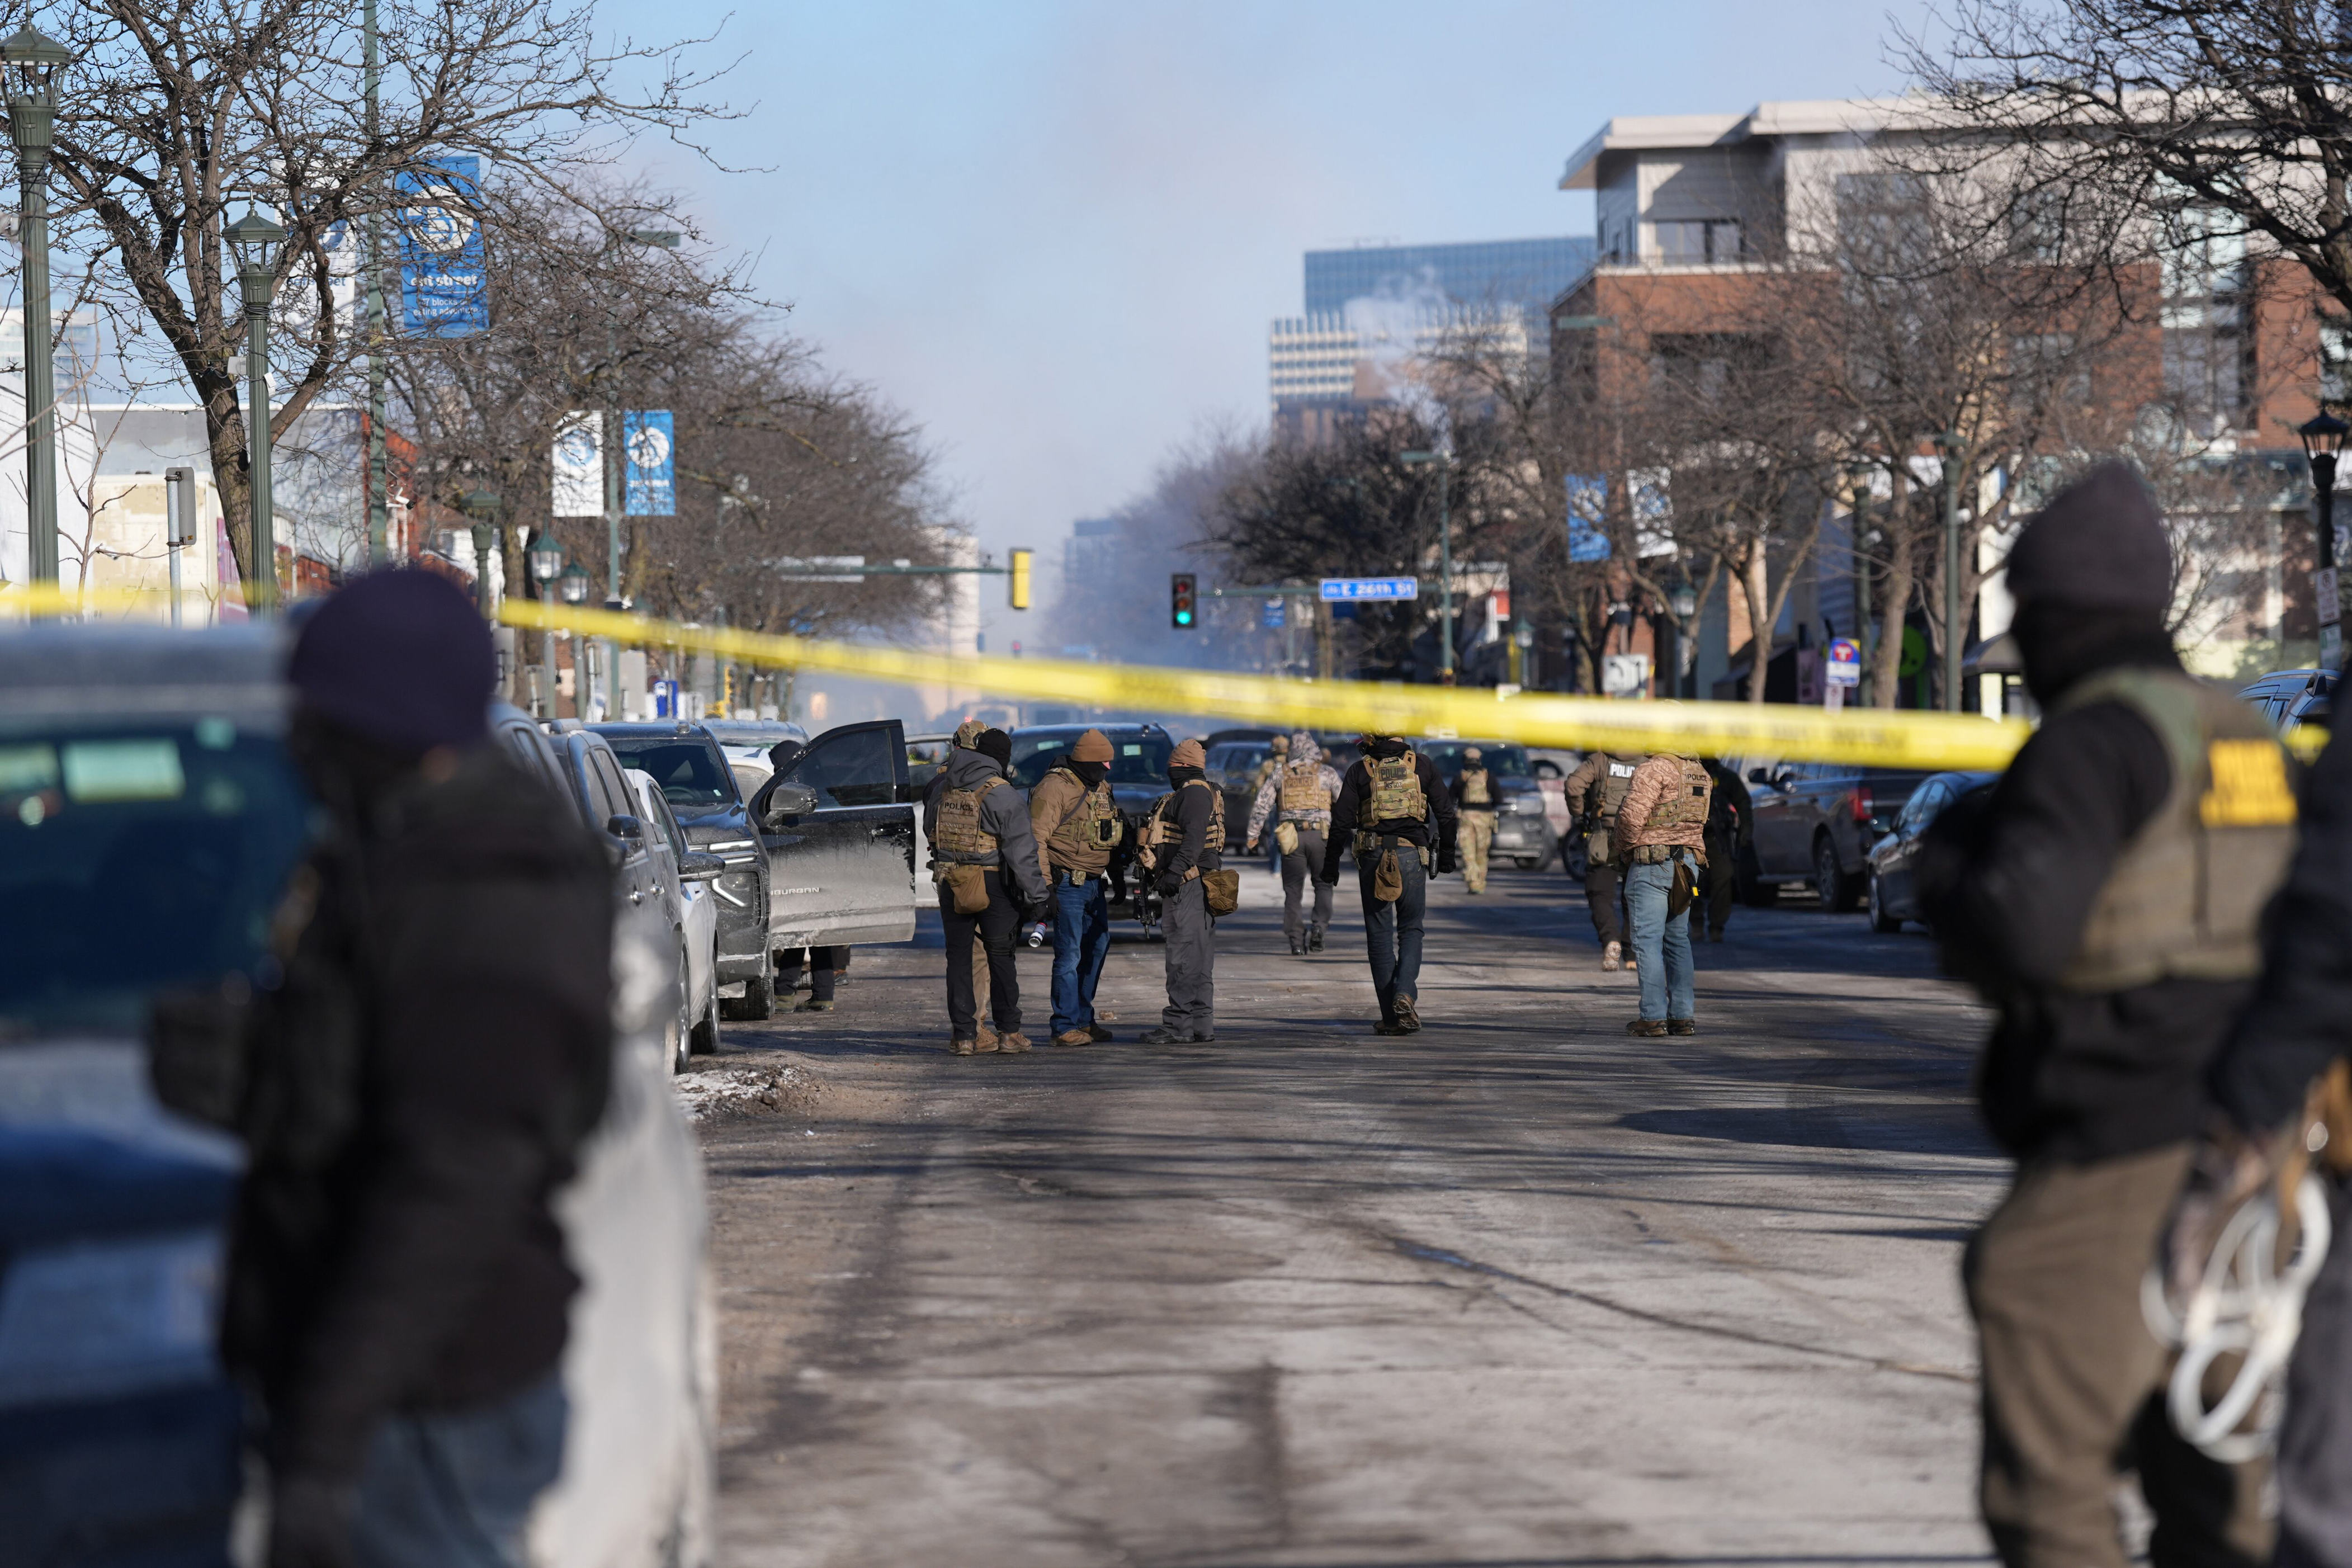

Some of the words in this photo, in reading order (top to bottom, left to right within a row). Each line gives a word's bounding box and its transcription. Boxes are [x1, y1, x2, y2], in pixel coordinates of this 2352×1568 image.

[436, 273, 478, 286] street
[432, 297, 457, 306] blocks
[1380, 767, 1406, 780] POLICE
[1609, 763, 1635, 778] POLIC
[1288, 778, 1313, 787] POLICE
[944, 802, 974, 811] POLICE
